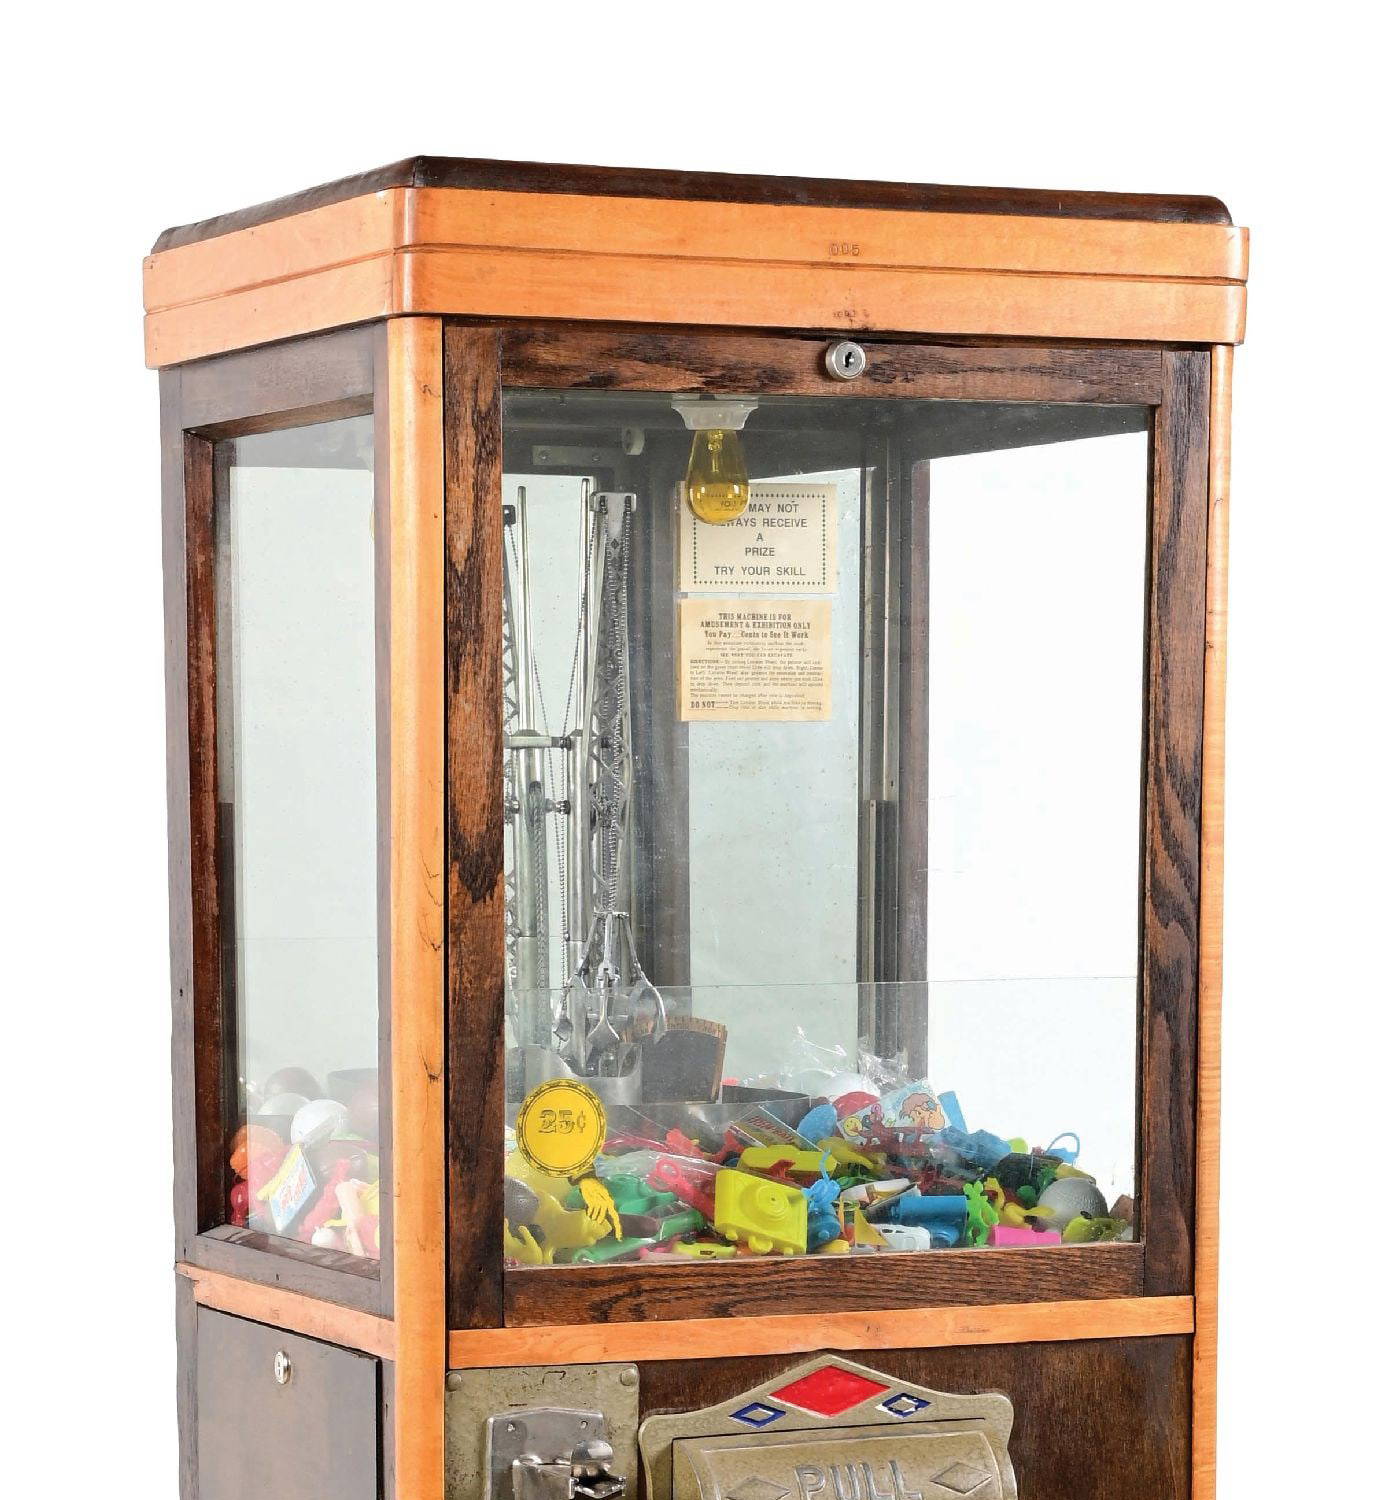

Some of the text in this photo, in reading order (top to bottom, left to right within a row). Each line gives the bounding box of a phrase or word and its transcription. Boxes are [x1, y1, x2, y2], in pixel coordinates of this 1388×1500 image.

[749, 503, 772, 513] MAY
[777, 503, 800, 513] NOT
[763, 518, 808, 528] RECEIVE
[756, 533, 764, 542] A
[745, 547, 776, 557] PRIZE
[714, 566, 807, 576] TRY YOUR SKILL
[718, 612, 735, 621] THIS
[736, 612, 768, 621] MACHINE
[777, 613, 792, 621] FOR
[700, 620, 744, 628] AMUSEMENT
[752, 621, 792, 629] EXHIBITION
[793, 621, 811, 629] ONLY
[704, 630, 717, 638] You
[718, 630, 732, 639] Pay
[791, 631, 809, 639] Work
[702, 700, 716, 709] NOT
